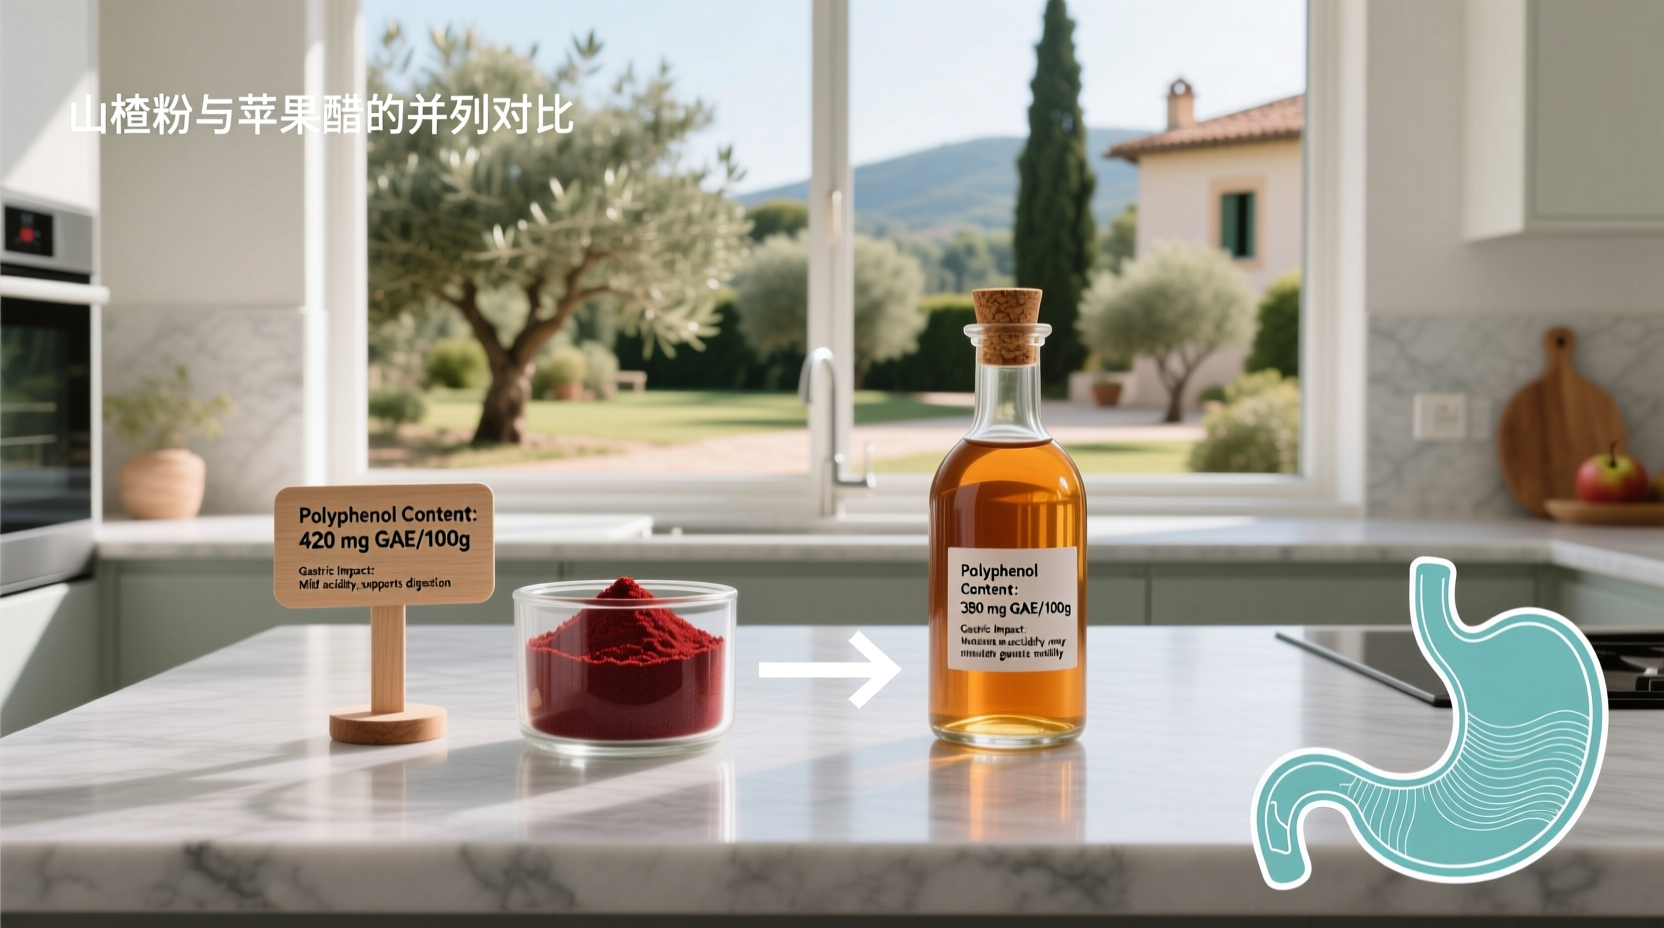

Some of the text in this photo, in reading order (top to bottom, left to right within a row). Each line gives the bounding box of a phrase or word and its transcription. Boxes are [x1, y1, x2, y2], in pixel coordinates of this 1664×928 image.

[299, 505, 478, 528] Polyphenol Content:
[299, 529, 471, 553] 420 mg GAE/100g
[298, 565, 335, 576] Gastric
[961, 563, 1038, 582] Polyphenol
[960, 583, 1018, 596] Content:
[987, 605, 1007, 618] mg
[1009, 601, 1072, 617] GAE/100g
